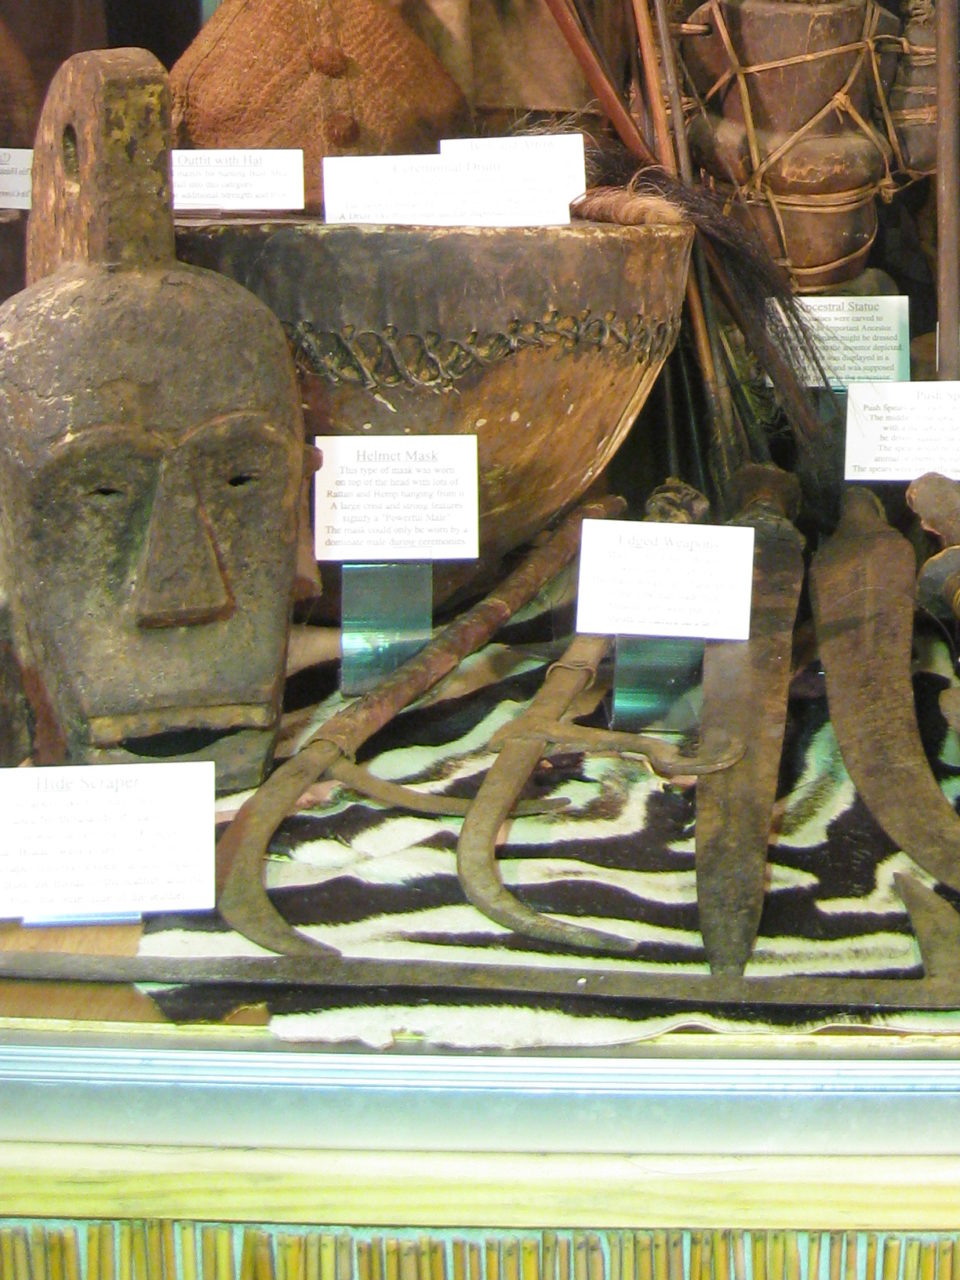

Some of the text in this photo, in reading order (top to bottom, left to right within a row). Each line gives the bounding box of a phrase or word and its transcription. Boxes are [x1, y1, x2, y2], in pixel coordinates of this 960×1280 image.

[177, 155, 263, 166] Outfit with Hat
[847, 302, 880, 312] Statue
[356, 450, 439, 462] Helmet Mask
